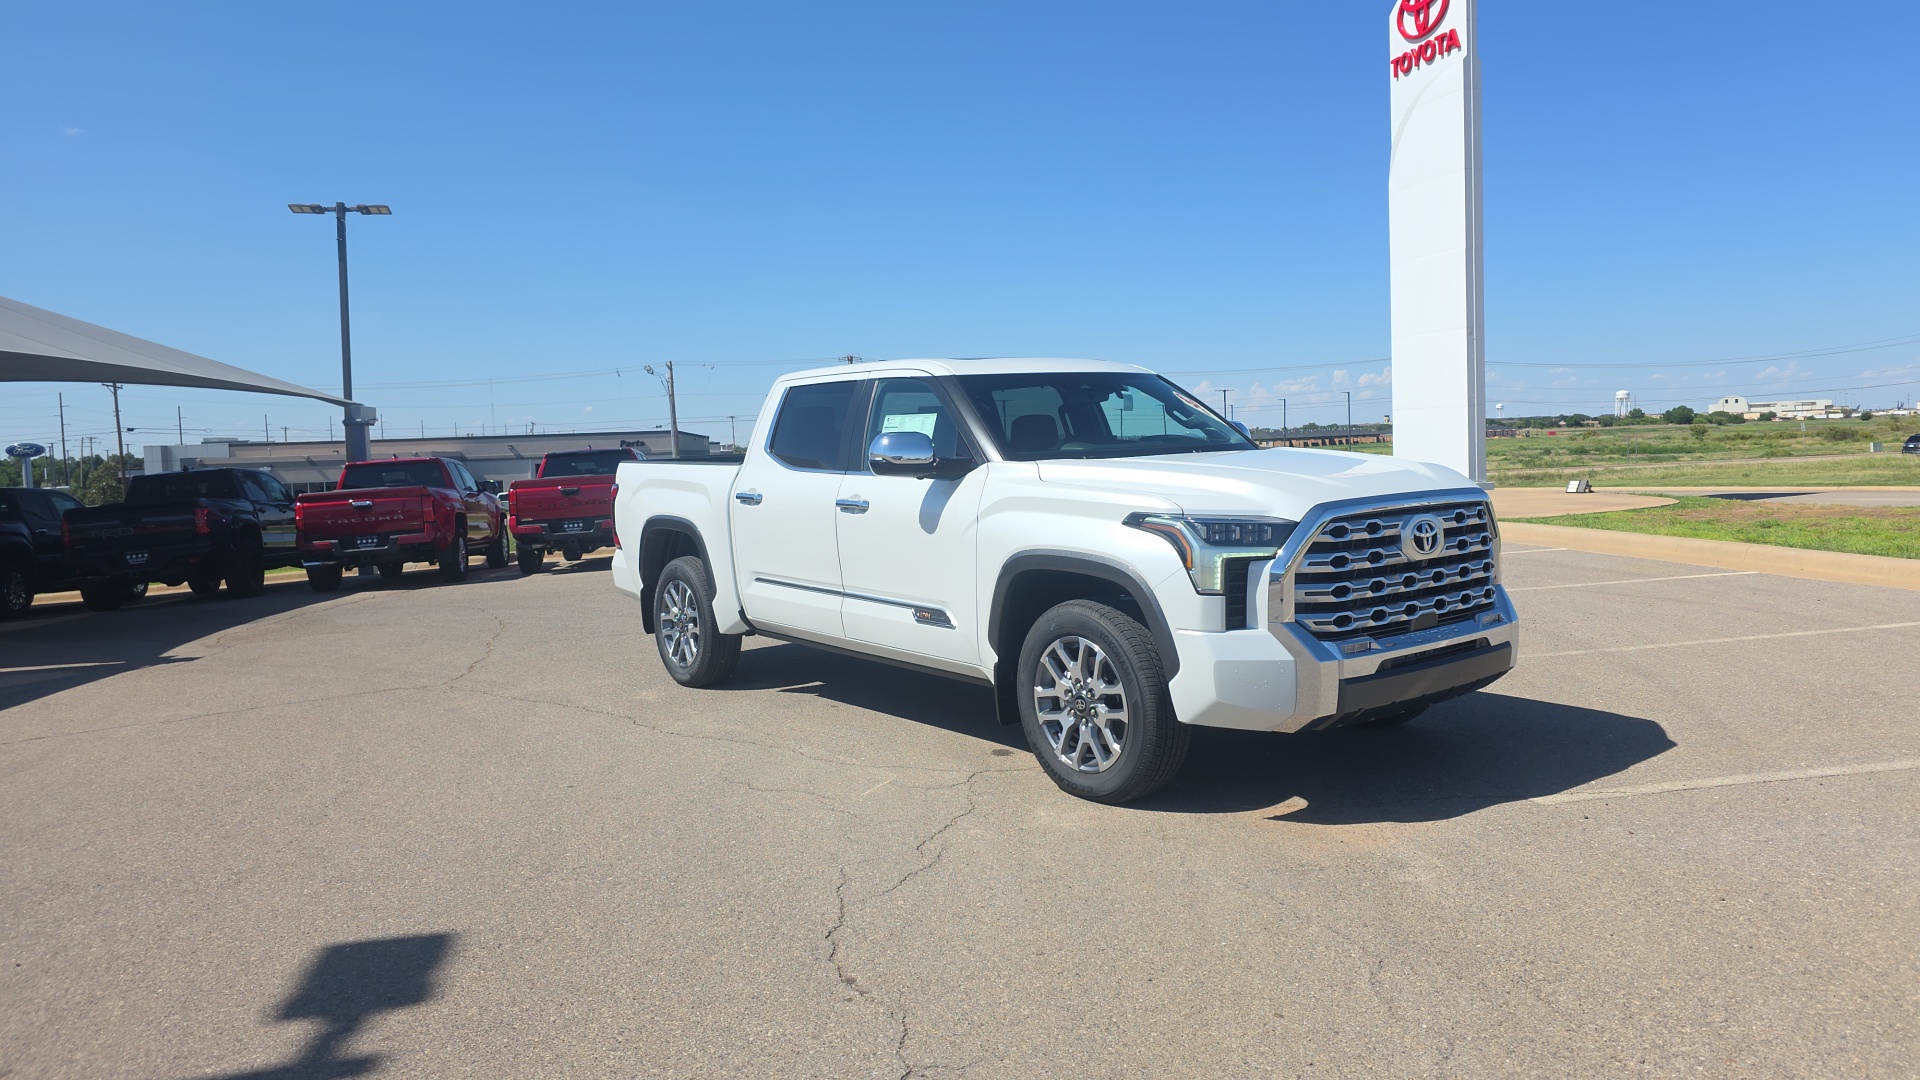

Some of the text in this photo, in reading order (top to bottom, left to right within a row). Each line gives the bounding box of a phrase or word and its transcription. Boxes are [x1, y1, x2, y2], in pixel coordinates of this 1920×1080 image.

[1390, 28, 1461, 79] TOYOTA
[620, 440, 646, 448] Parts
[13, 445, 36, 456] Ford
[324, 514, 404, 524] TACOMA
[1099, 630, 1134, 686] YOKOHAMA
